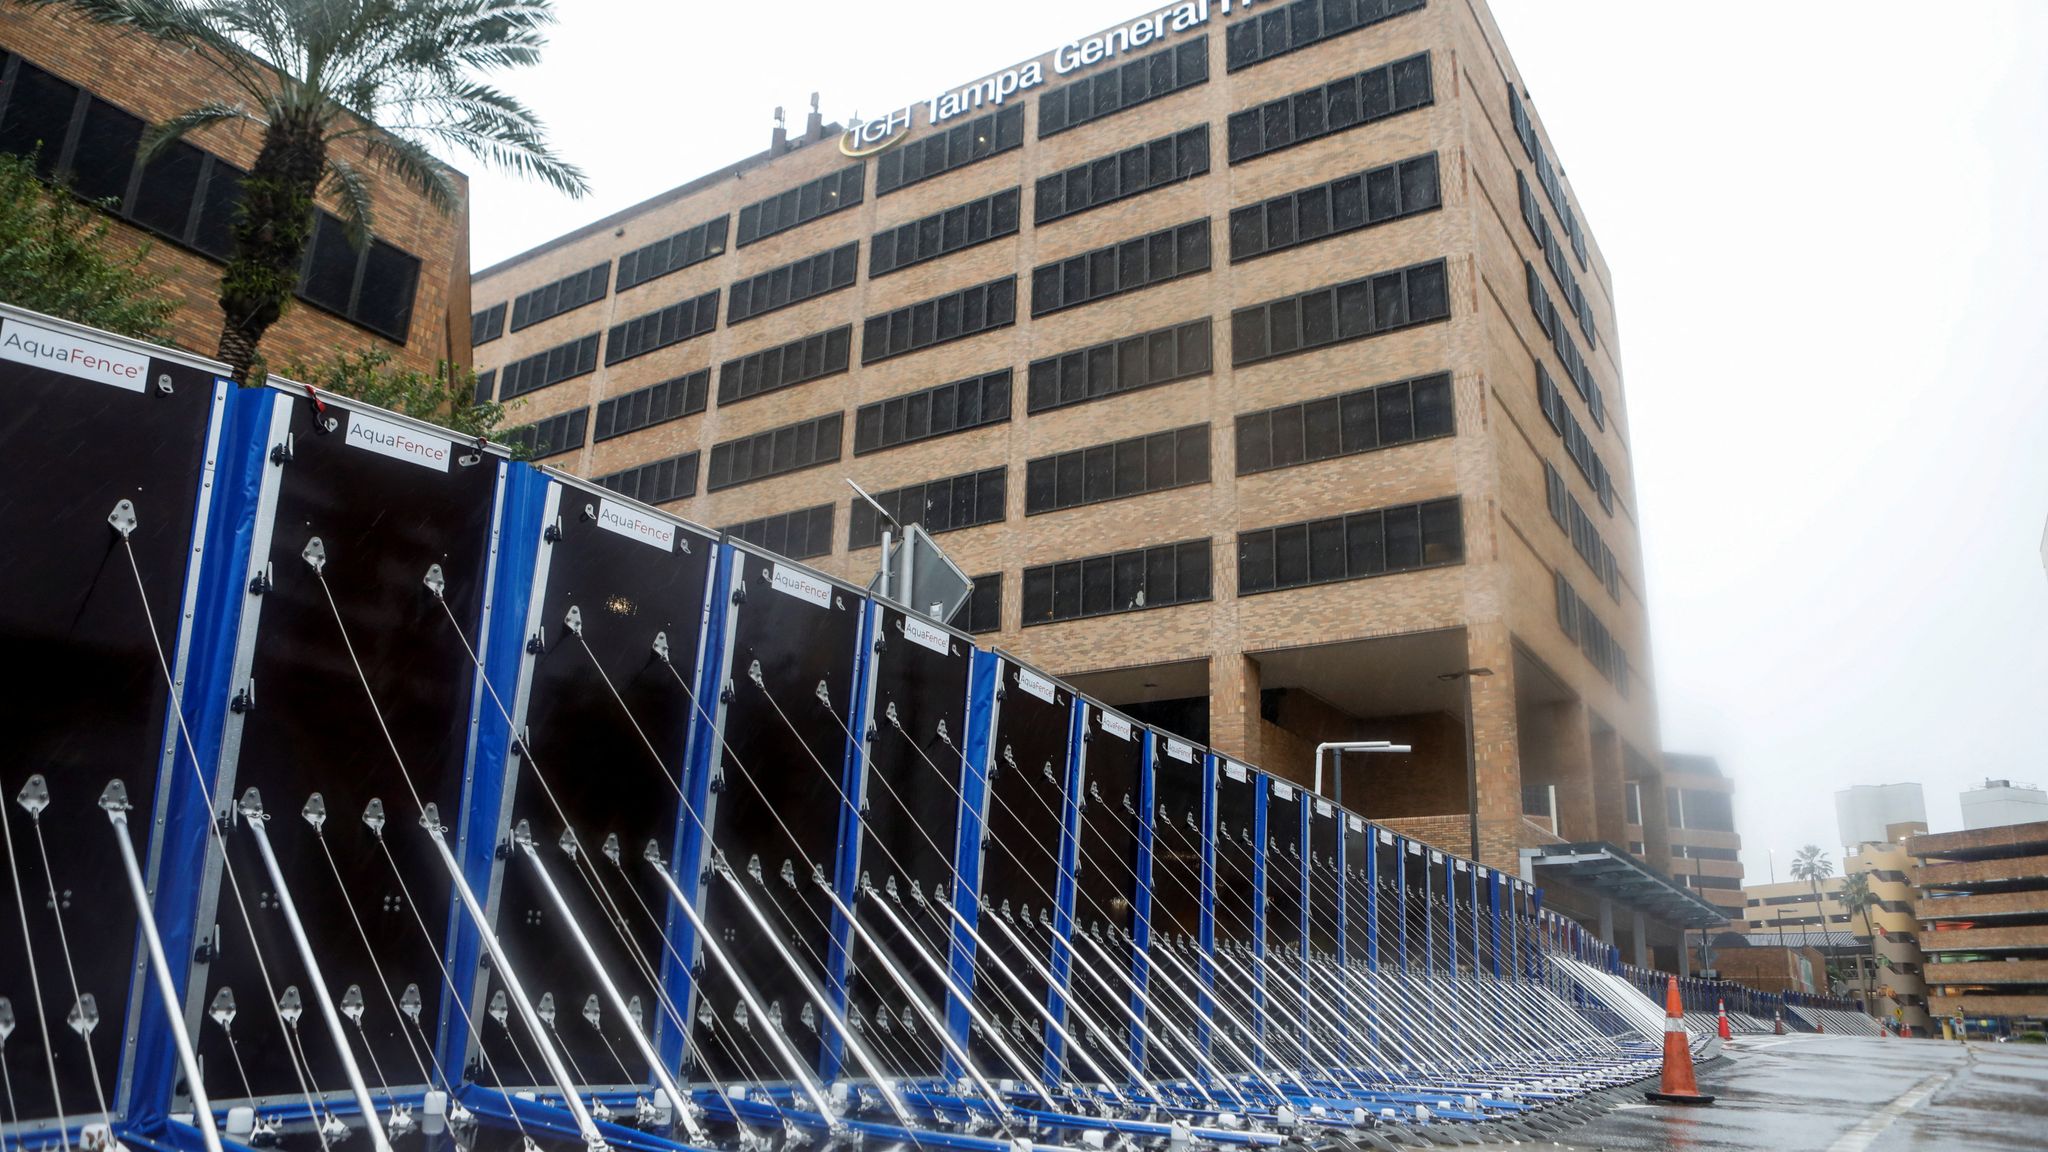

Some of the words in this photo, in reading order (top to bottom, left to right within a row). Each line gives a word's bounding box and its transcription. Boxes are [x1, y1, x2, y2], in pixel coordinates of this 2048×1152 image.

[850, 105, 911, 150] TGH
[924, 60, 1042, 124] Tampa
[1053, 0, 1209, 76] General
[4, 332, 144, 379] AquaFence
[350, 423, 447, 461] AquaFence
